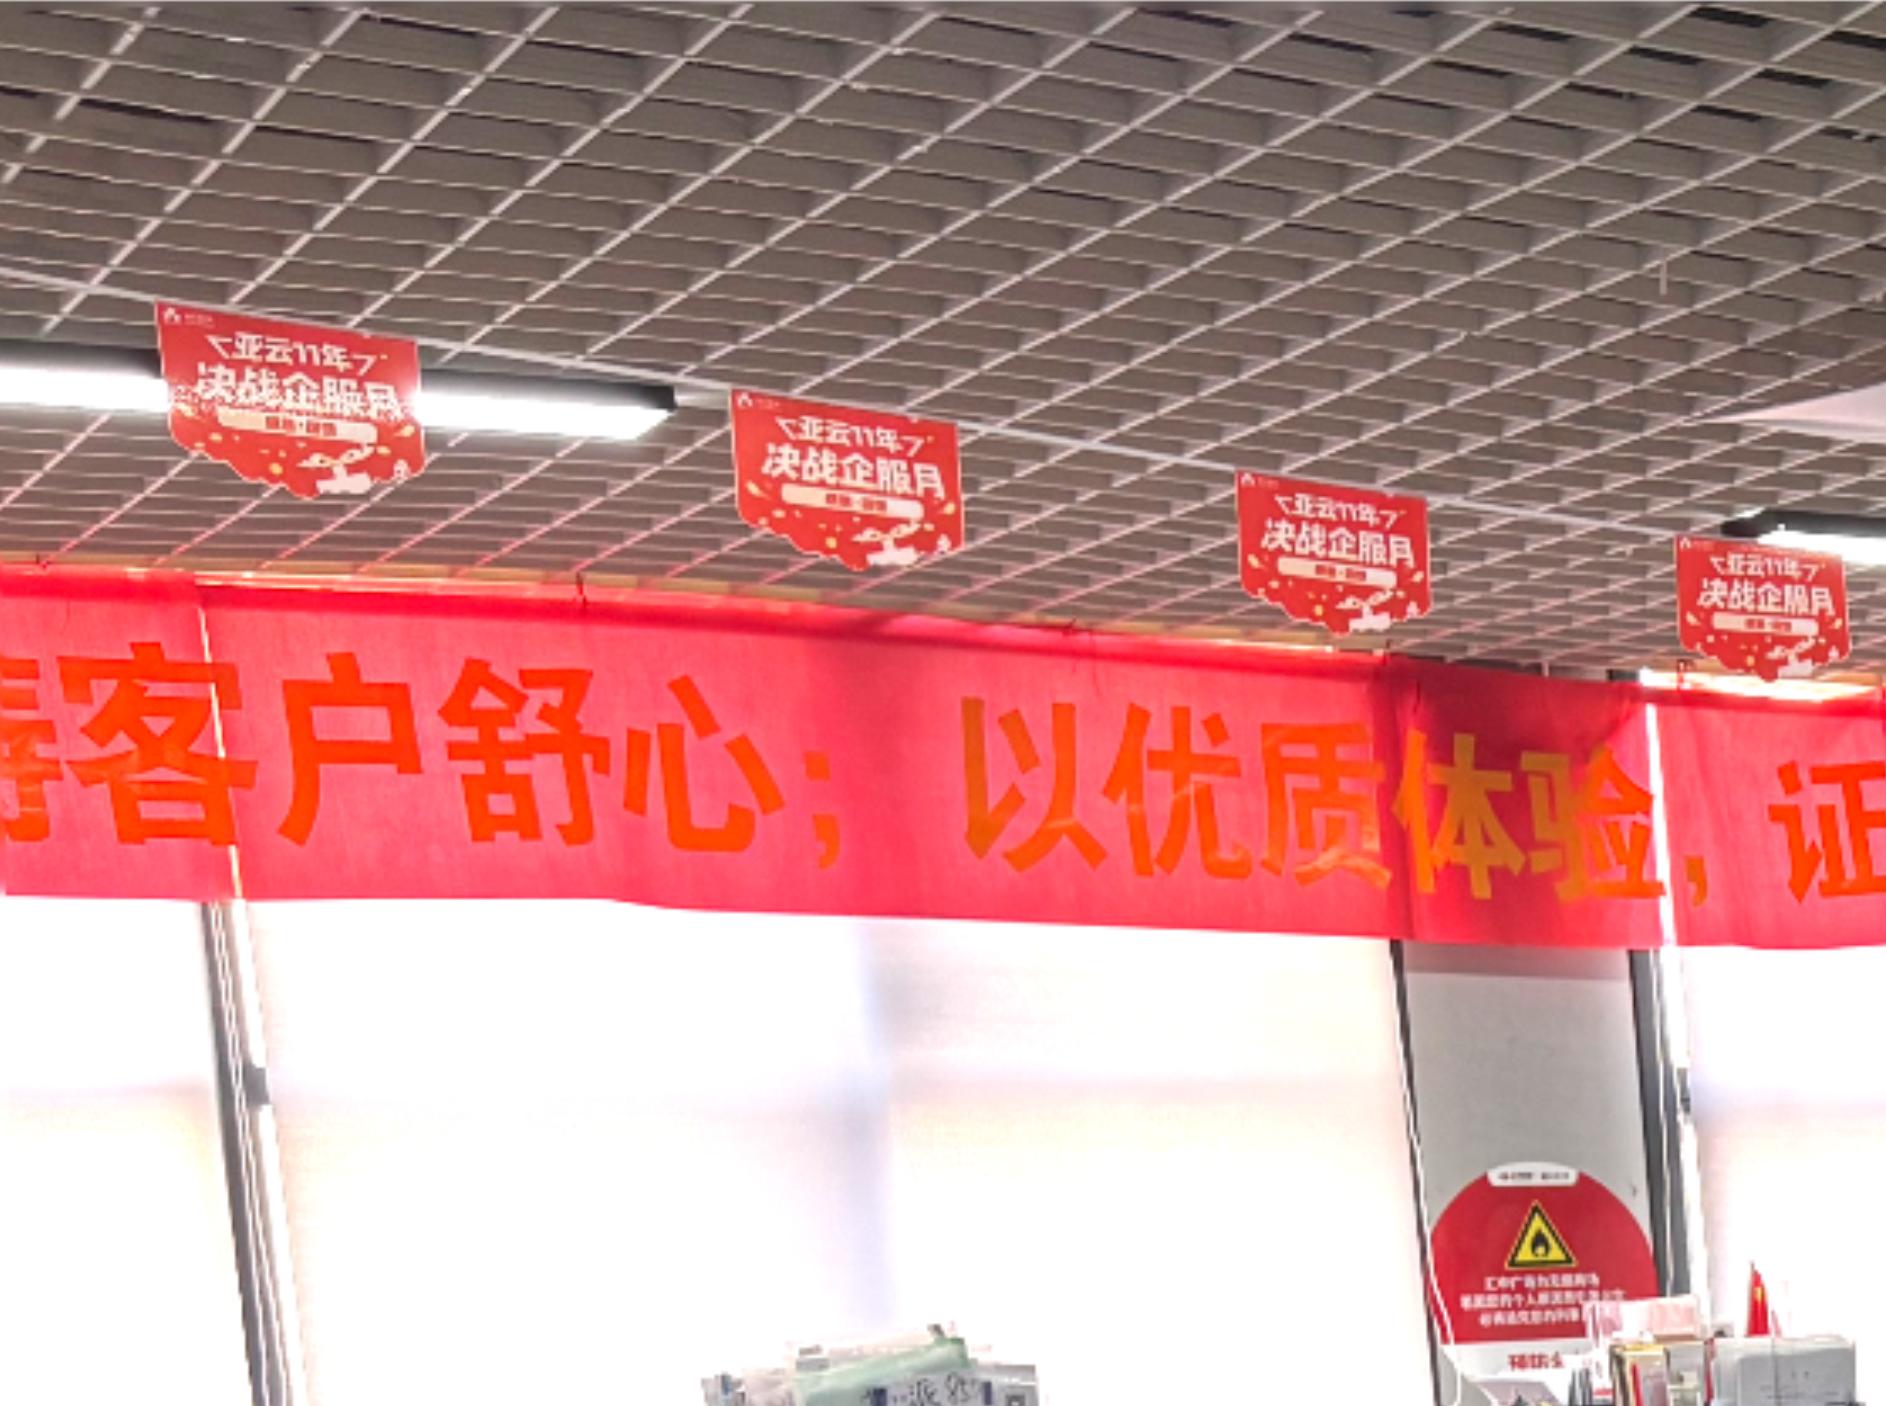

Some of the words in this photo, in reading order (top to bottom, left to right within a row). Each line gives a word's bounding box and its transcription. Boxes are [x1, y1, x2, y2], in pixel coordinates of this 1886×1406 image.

[232, 331, 354, 373] 亚云11年
[797, 414, 905, 455] 亚云11年
[761, 442, 946, 501] 决战企服月
[1293, 492, 1381, 528] 亚云11年
[1260, 517, 1415, 569] 决战企服月
[1696, 577, 1836, 617] 决战企服月
